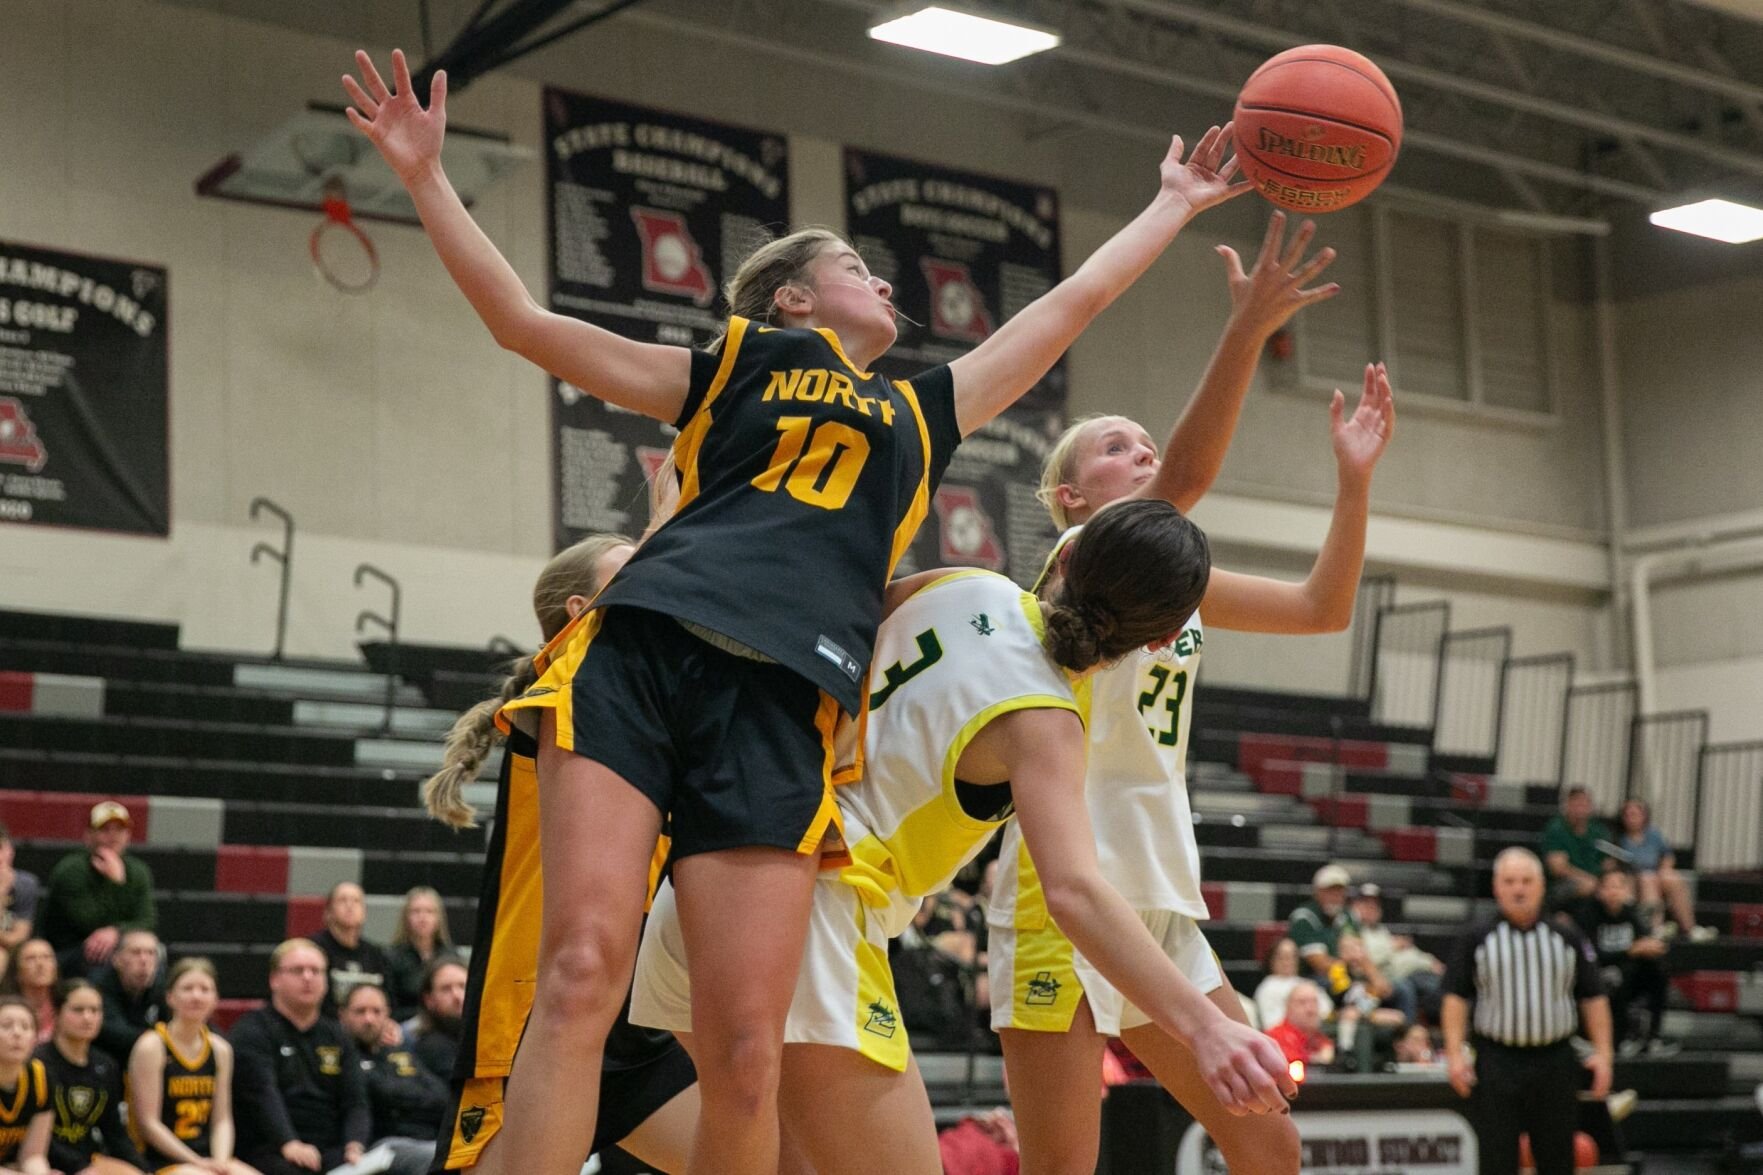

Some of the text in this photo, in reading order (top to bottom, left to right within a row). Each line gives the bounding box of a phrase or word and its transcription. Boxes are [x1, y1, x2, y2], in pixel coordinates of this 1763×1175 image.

[1255, 127, 1367, 170] SPALDING
[750, 416, 871, 510] 10
[847, 661, 857, 673] M
[868, 628, 943, 712] 3
[1137, 664, 1188, 747] 23
